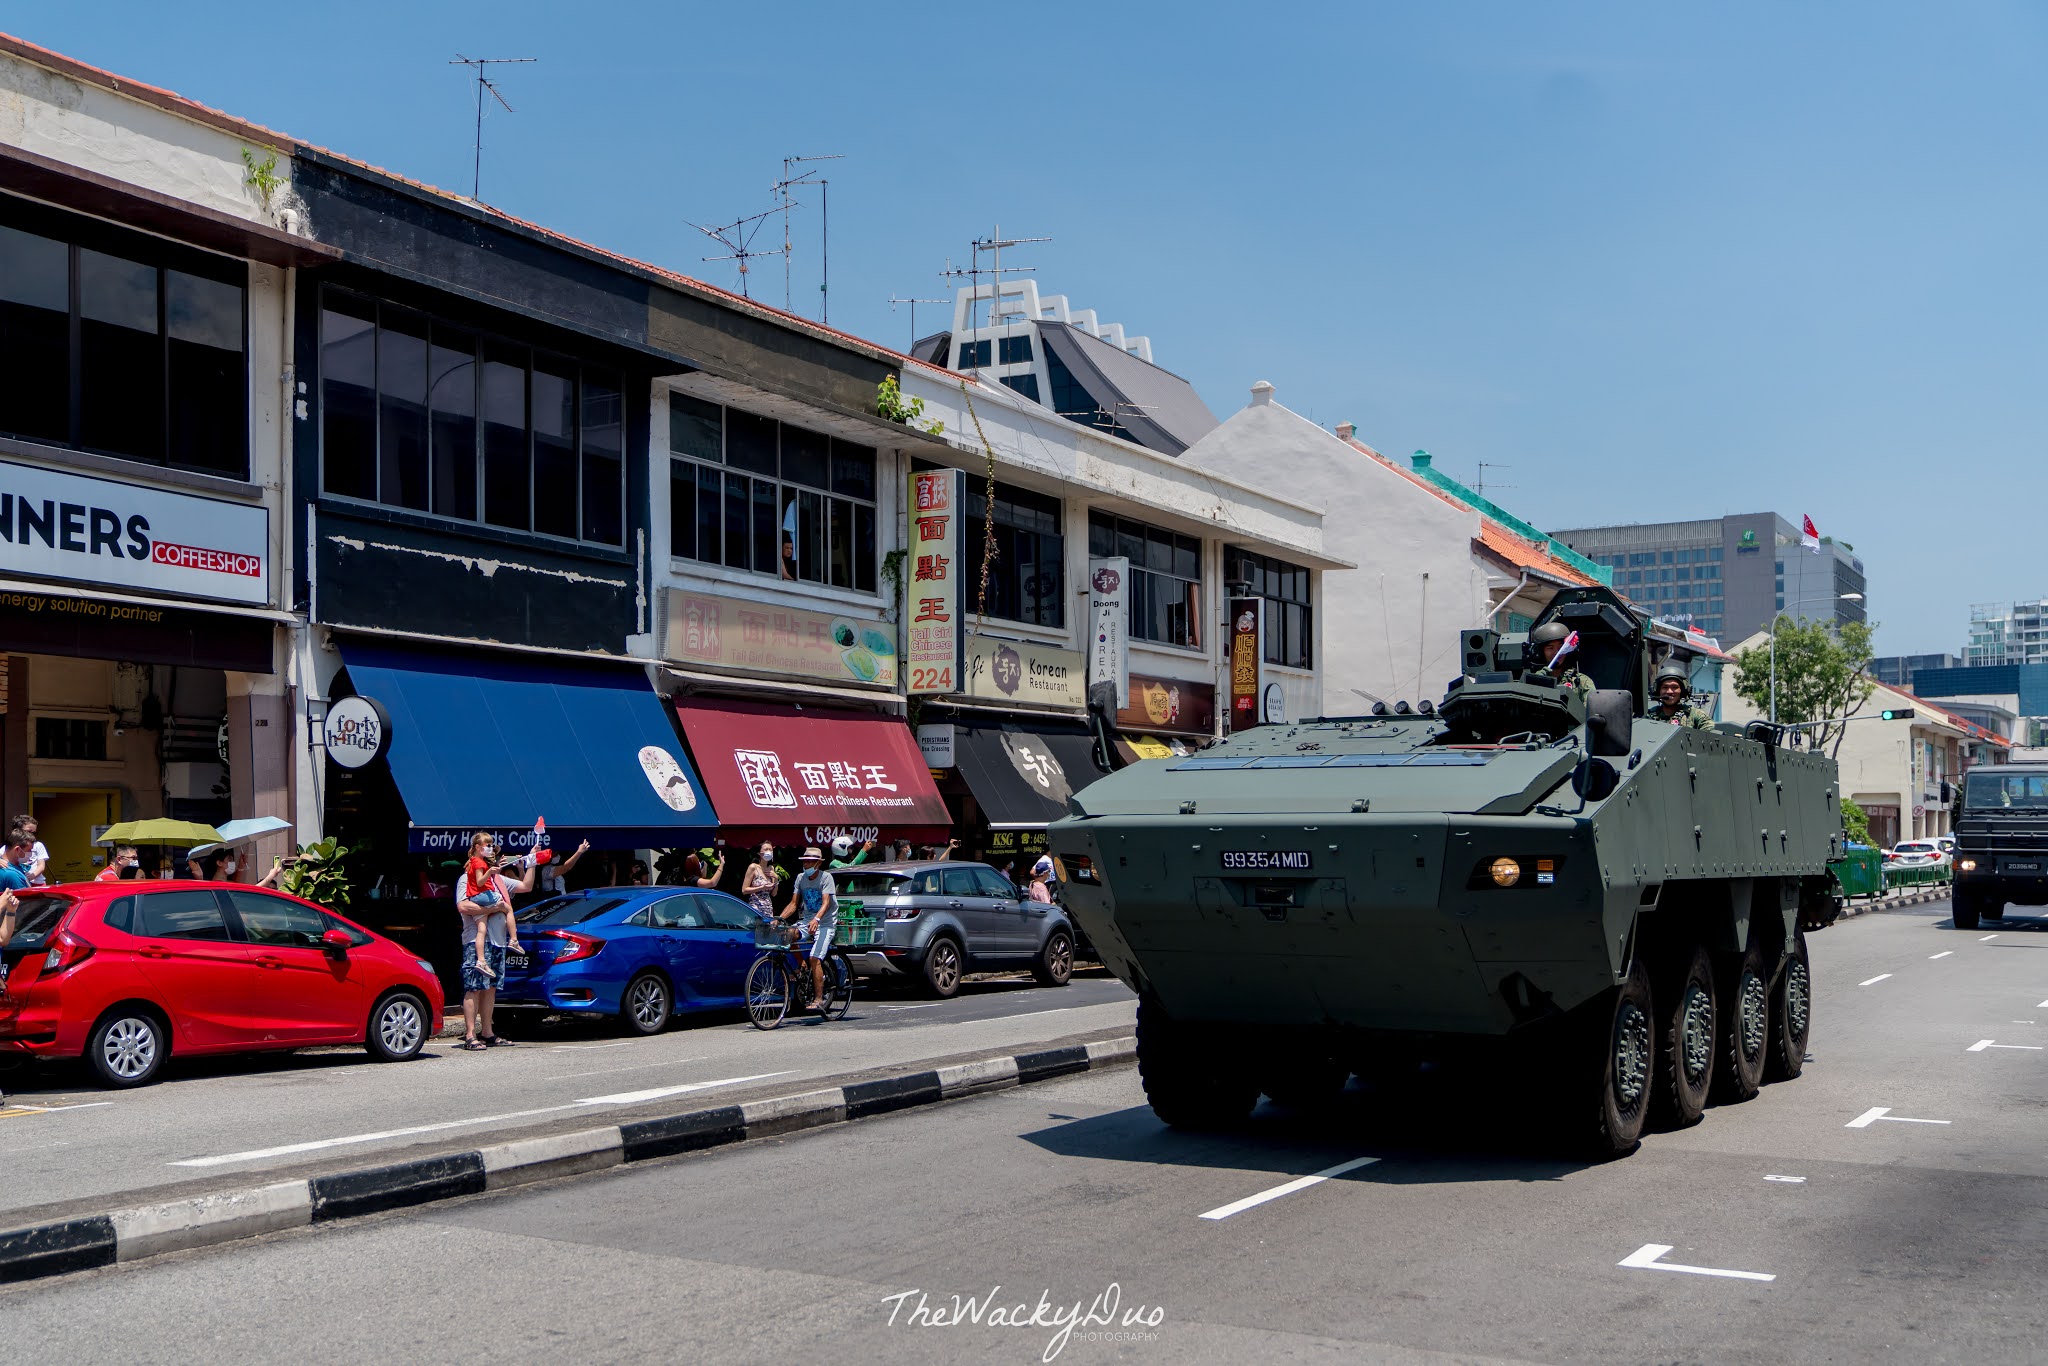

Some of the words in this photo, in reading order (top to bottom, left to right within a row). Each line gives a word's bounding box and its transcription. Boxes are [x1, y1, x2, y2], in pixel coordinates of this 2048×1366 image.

[154, 543, 260, 575] COFFEESHOP
[915, 515, 950, 622] 面點王
[0, 593, 46, 611] nergy
[51, 599, 106, 615] solution
[110, 606, 163, 622] partner
[1093, 600, 1119, 608] Doong
[1102, 609, 1110, 617] Ji
[738, 609, 833, 653] 面點王
[910, 628, 930, 640] Tall
[932, 626, 952, 639] Girl
[911, 640, 952, 651] Chinese
[731, 648, 747, 661] Tall
[765, 652, 799, 668] Chinese
[801, 657, 841, 673] Restaurant
[911, 652, 952, 661] Restaurant
[879, 669, 892, 680] 224
[1029, 658, 1067, 678] Korean
[912, 667, 952, 689] 224
[1029, 677, 1068, 692] Restaurant
[337, 714, 379, 737] forty
[793, 761, 897, 792] 面點王
[801, 794, 817, 806] Tall
[820, 795, 834, 807] Girl
[838, 796, 870, 807] Chinese
[871, 796, 914, 807] Restaurant
[422, 830, 457, 850] Forty
[460, 830, 504, 847] Hds
[508, 830, 551, 847] Coffee
[816, 826, 846, 844] 6344
[850, 826, 879, 843] 7002
[993, 833, 1014, 847] KSG
[1223, 852, 1309, 868] 99354MID
